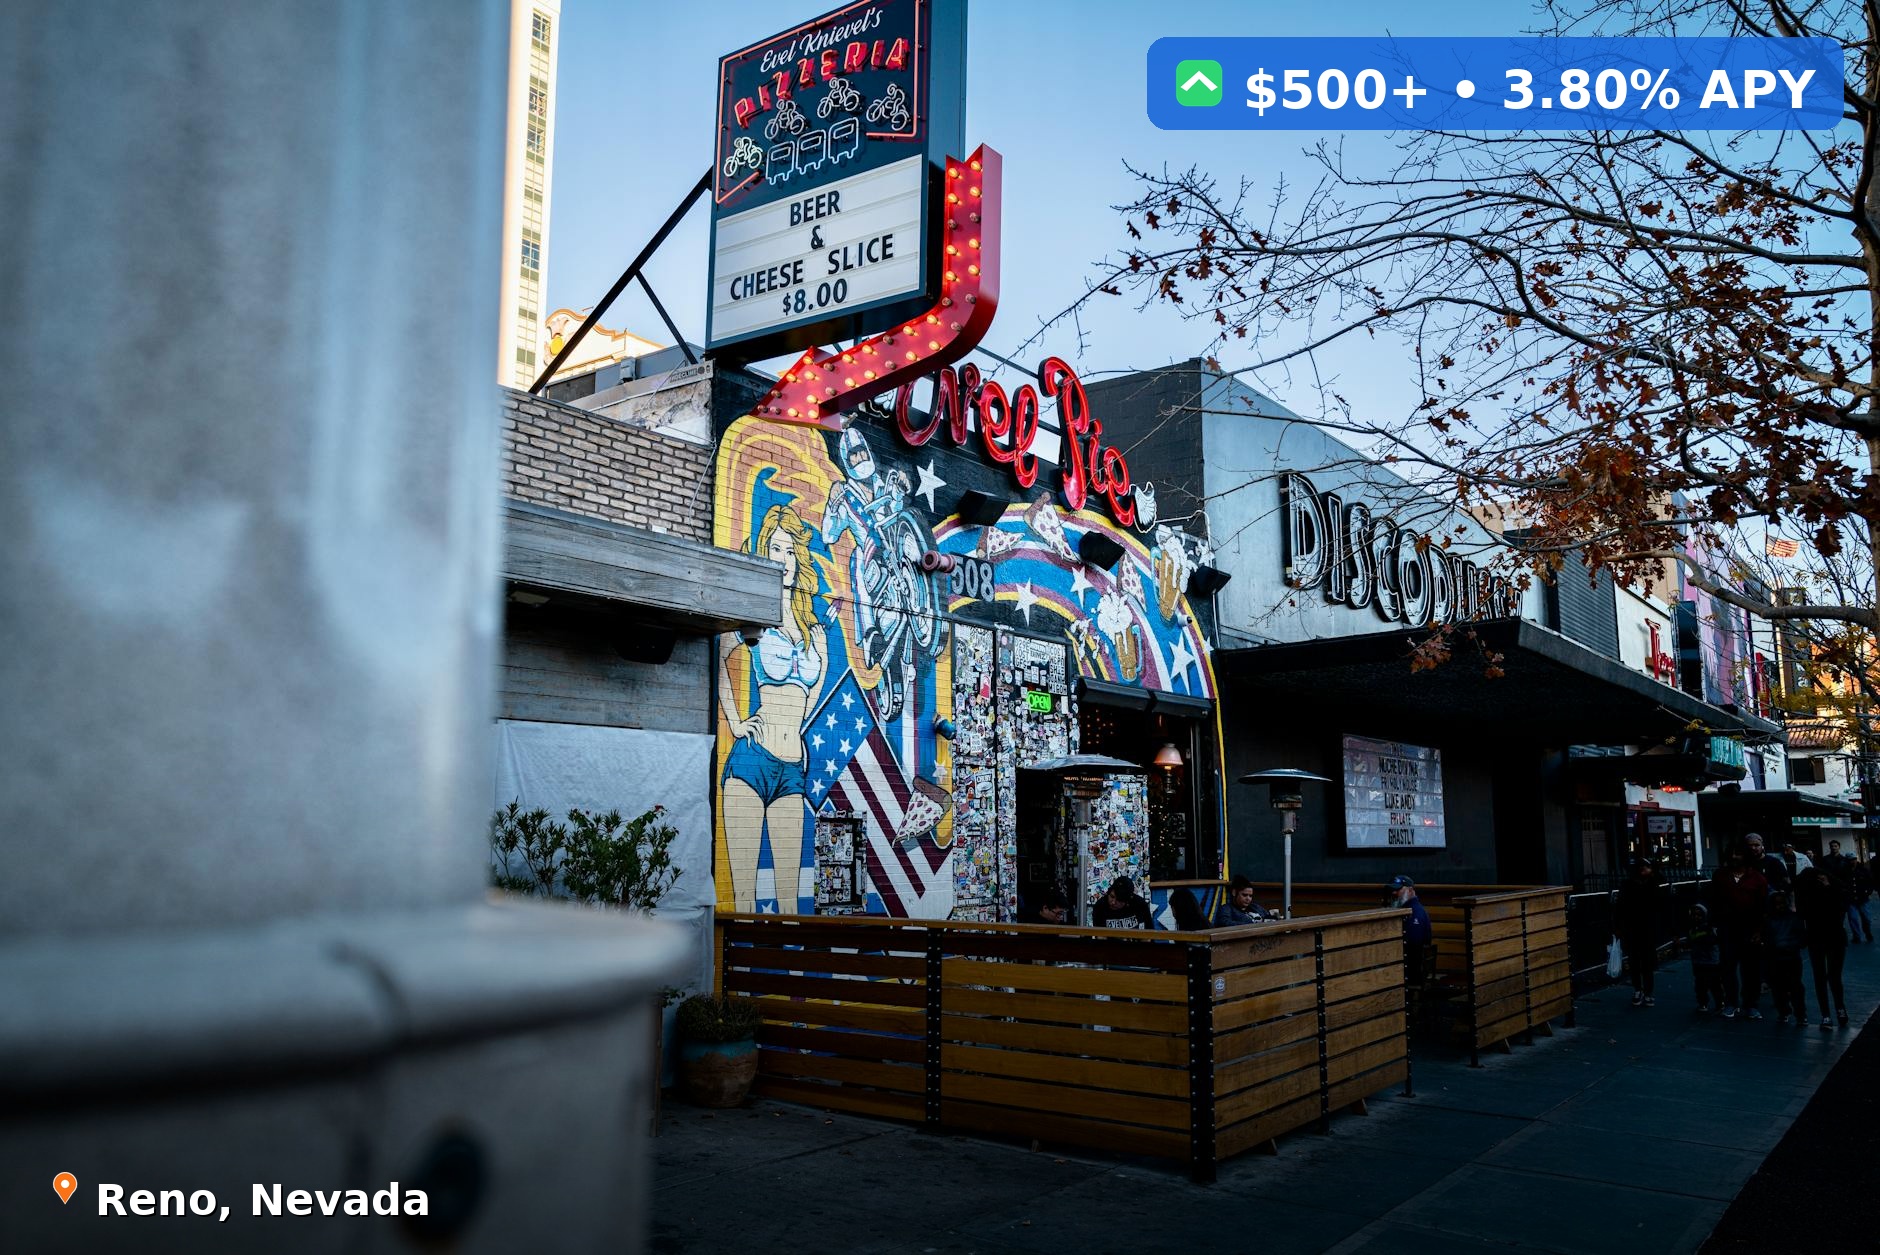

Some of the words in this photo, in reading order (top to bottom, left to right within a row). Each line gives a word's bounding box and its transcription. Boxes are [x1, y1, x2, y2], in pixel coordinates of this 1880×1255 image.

[760, 44, 796, 73] Evel
[799, 6, 884, 60] Knievel's
[734, 37, 911, 128] PIZZERIA
[789, 189, 841, 227] BEER
[810, 224, 825, 250] &
[729, 259, 804, 301] CHEESE
[828, 233, 894, 276] SLICE
[782, 278, 848, 314] $8.00
[951, 557, 995, 601] 508
[1028, 693, 1050, 709] OPEN
[1388, 828, 1415, 845] GHASTLY
